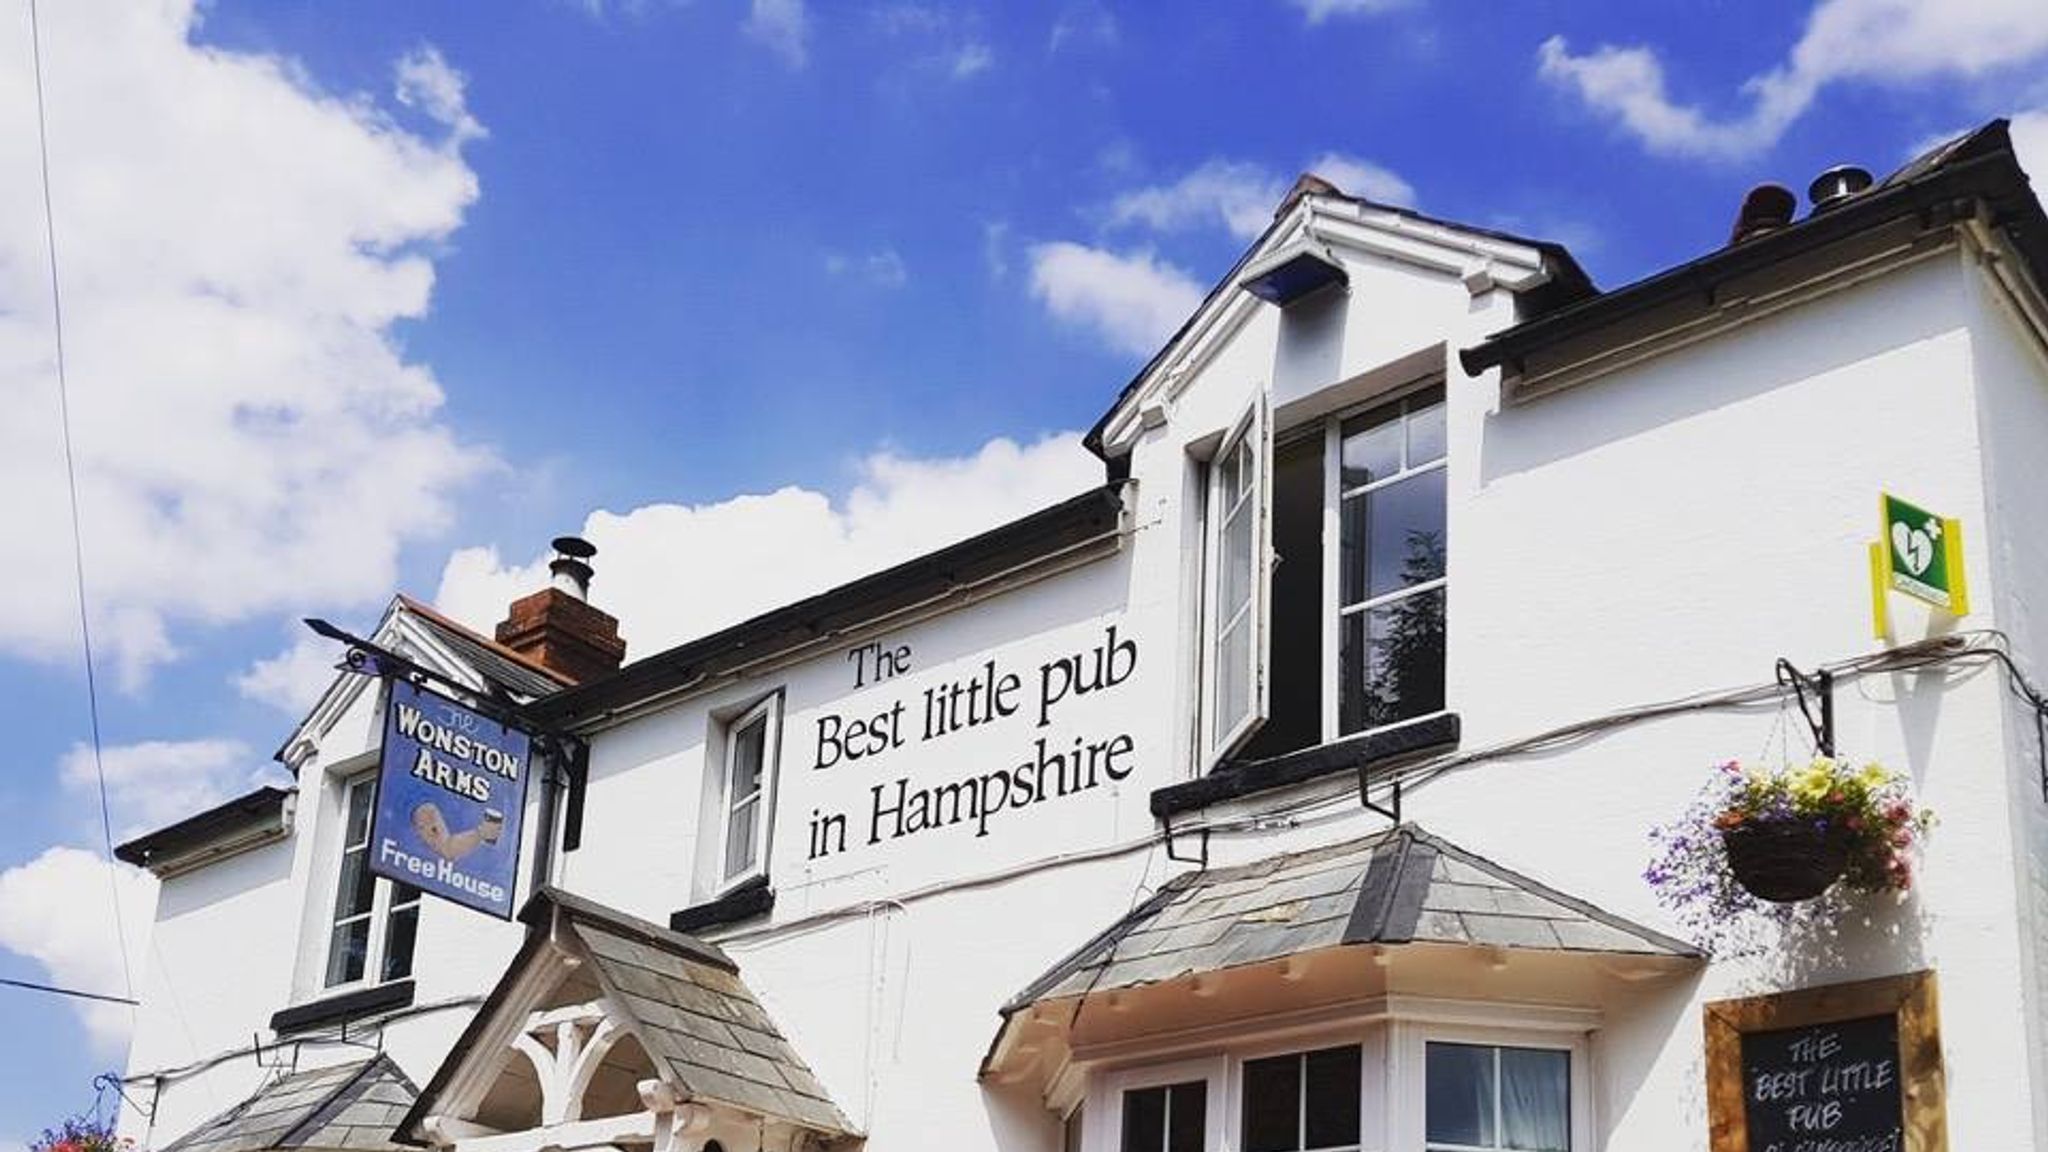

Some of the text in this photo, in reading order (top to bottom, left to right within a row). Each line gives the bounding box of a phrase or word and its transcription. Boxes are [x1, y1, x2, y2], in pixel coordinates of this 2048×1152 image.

[847, 640, 912, 690] The
[813, 624, 1138, 771] Best little pub
[396, 704, 519, 779] WONSTON
[412, 749, 490, 802] ARMS
[807, 734, 1134, 861] in Hampshire
[1788, 1032, 1842, 1063] THE
[1821, 1059, 1894, 1095] LITTLE
[1787, 1100, 1843, 1131] PUB
